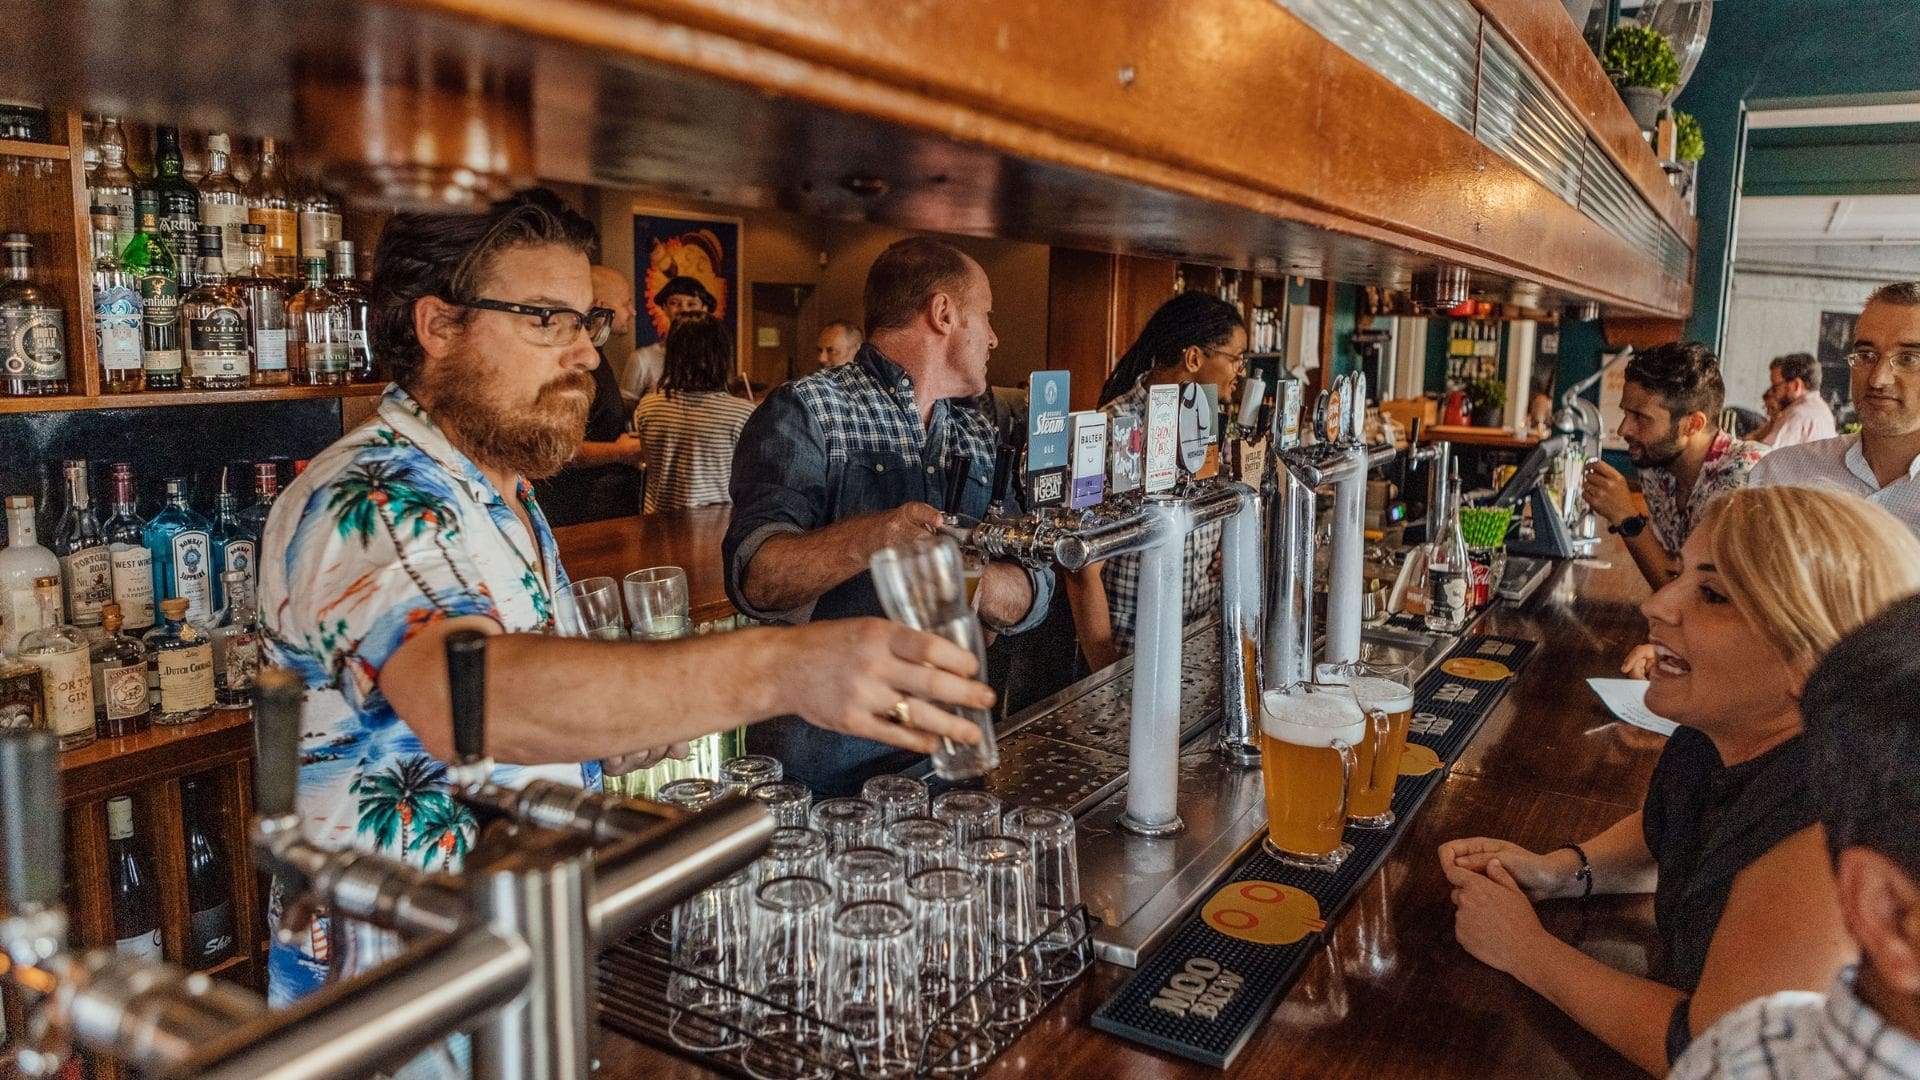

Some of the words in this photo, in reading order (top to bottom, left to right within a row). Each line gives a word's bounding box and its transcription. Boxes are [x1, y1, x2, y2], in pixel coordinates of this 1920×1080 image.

[1080, 433, 1103, 445] BALTER
[1039, 481, 1062, 500] GOAT
[114, 560, 136, 569] WEST
[1149, 957, 1221, 1018] MOO
[1189, 968, 1245, 1022] BREW
